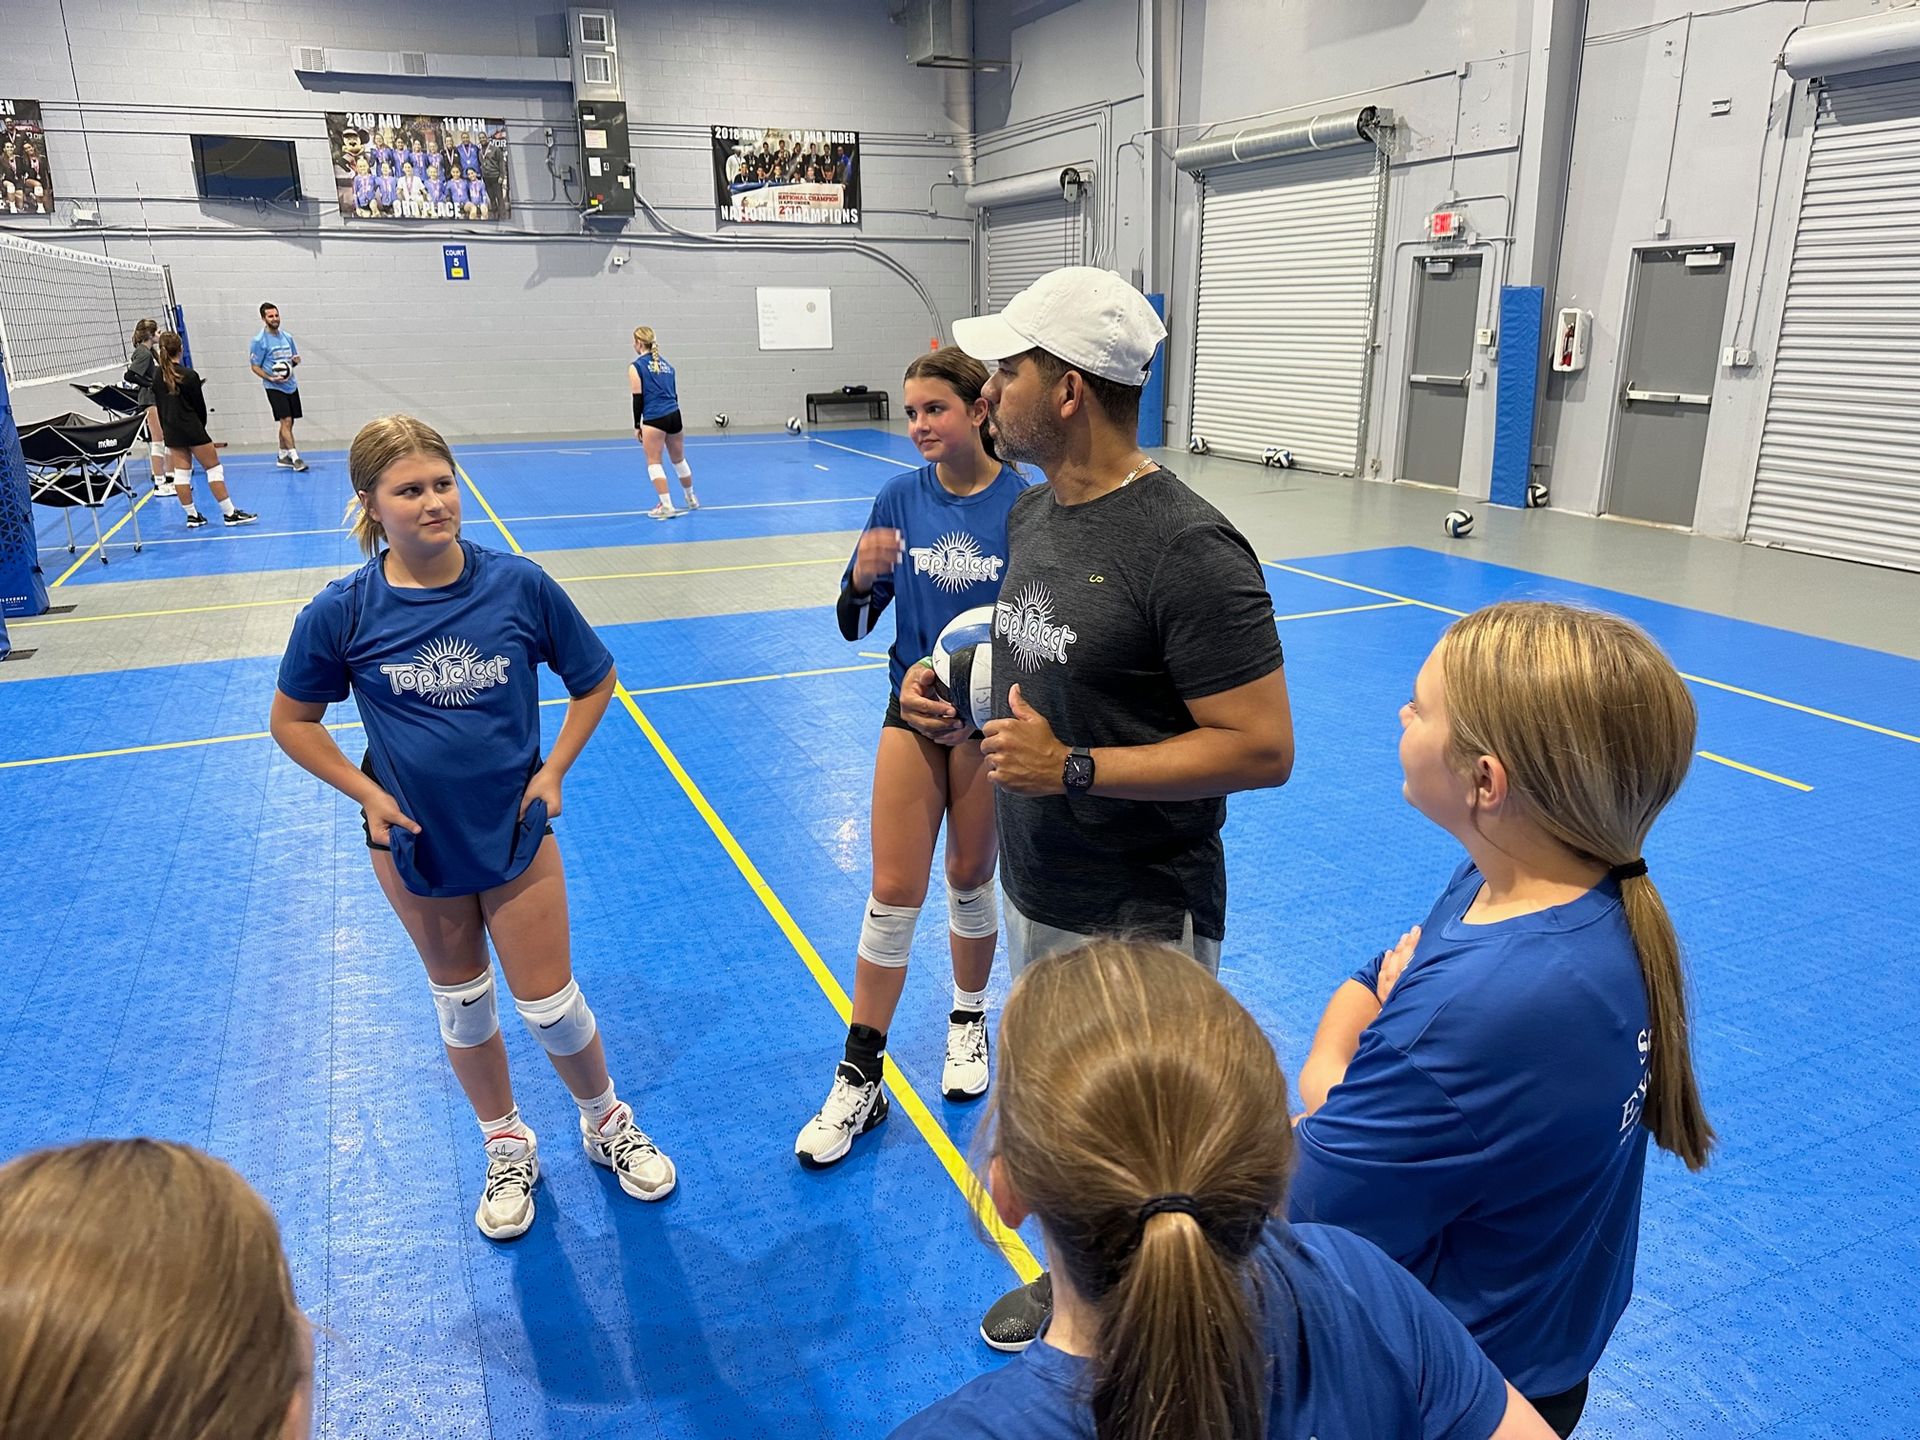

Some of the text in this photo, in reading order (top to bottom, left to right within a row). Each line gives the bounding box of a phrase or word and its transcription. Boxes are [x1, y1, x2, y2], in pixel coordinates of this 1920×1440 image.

[346, 113, 375, 128] 2019
[378, 114, 401, 129] AAU
[443, 117, 454, 131] 11
[457, 118, 486, 132] OPEN
[714, 126, 739, 140] 2018
[825, 130, 856, 144] UNDER
[422, 201, 463, 219] PLACE
[721, 204, 859, 225] NATIONAL CHAMPIONS
[1434, 213, 1453, 232] EXIT
[453, 257, 460, 267] 5
